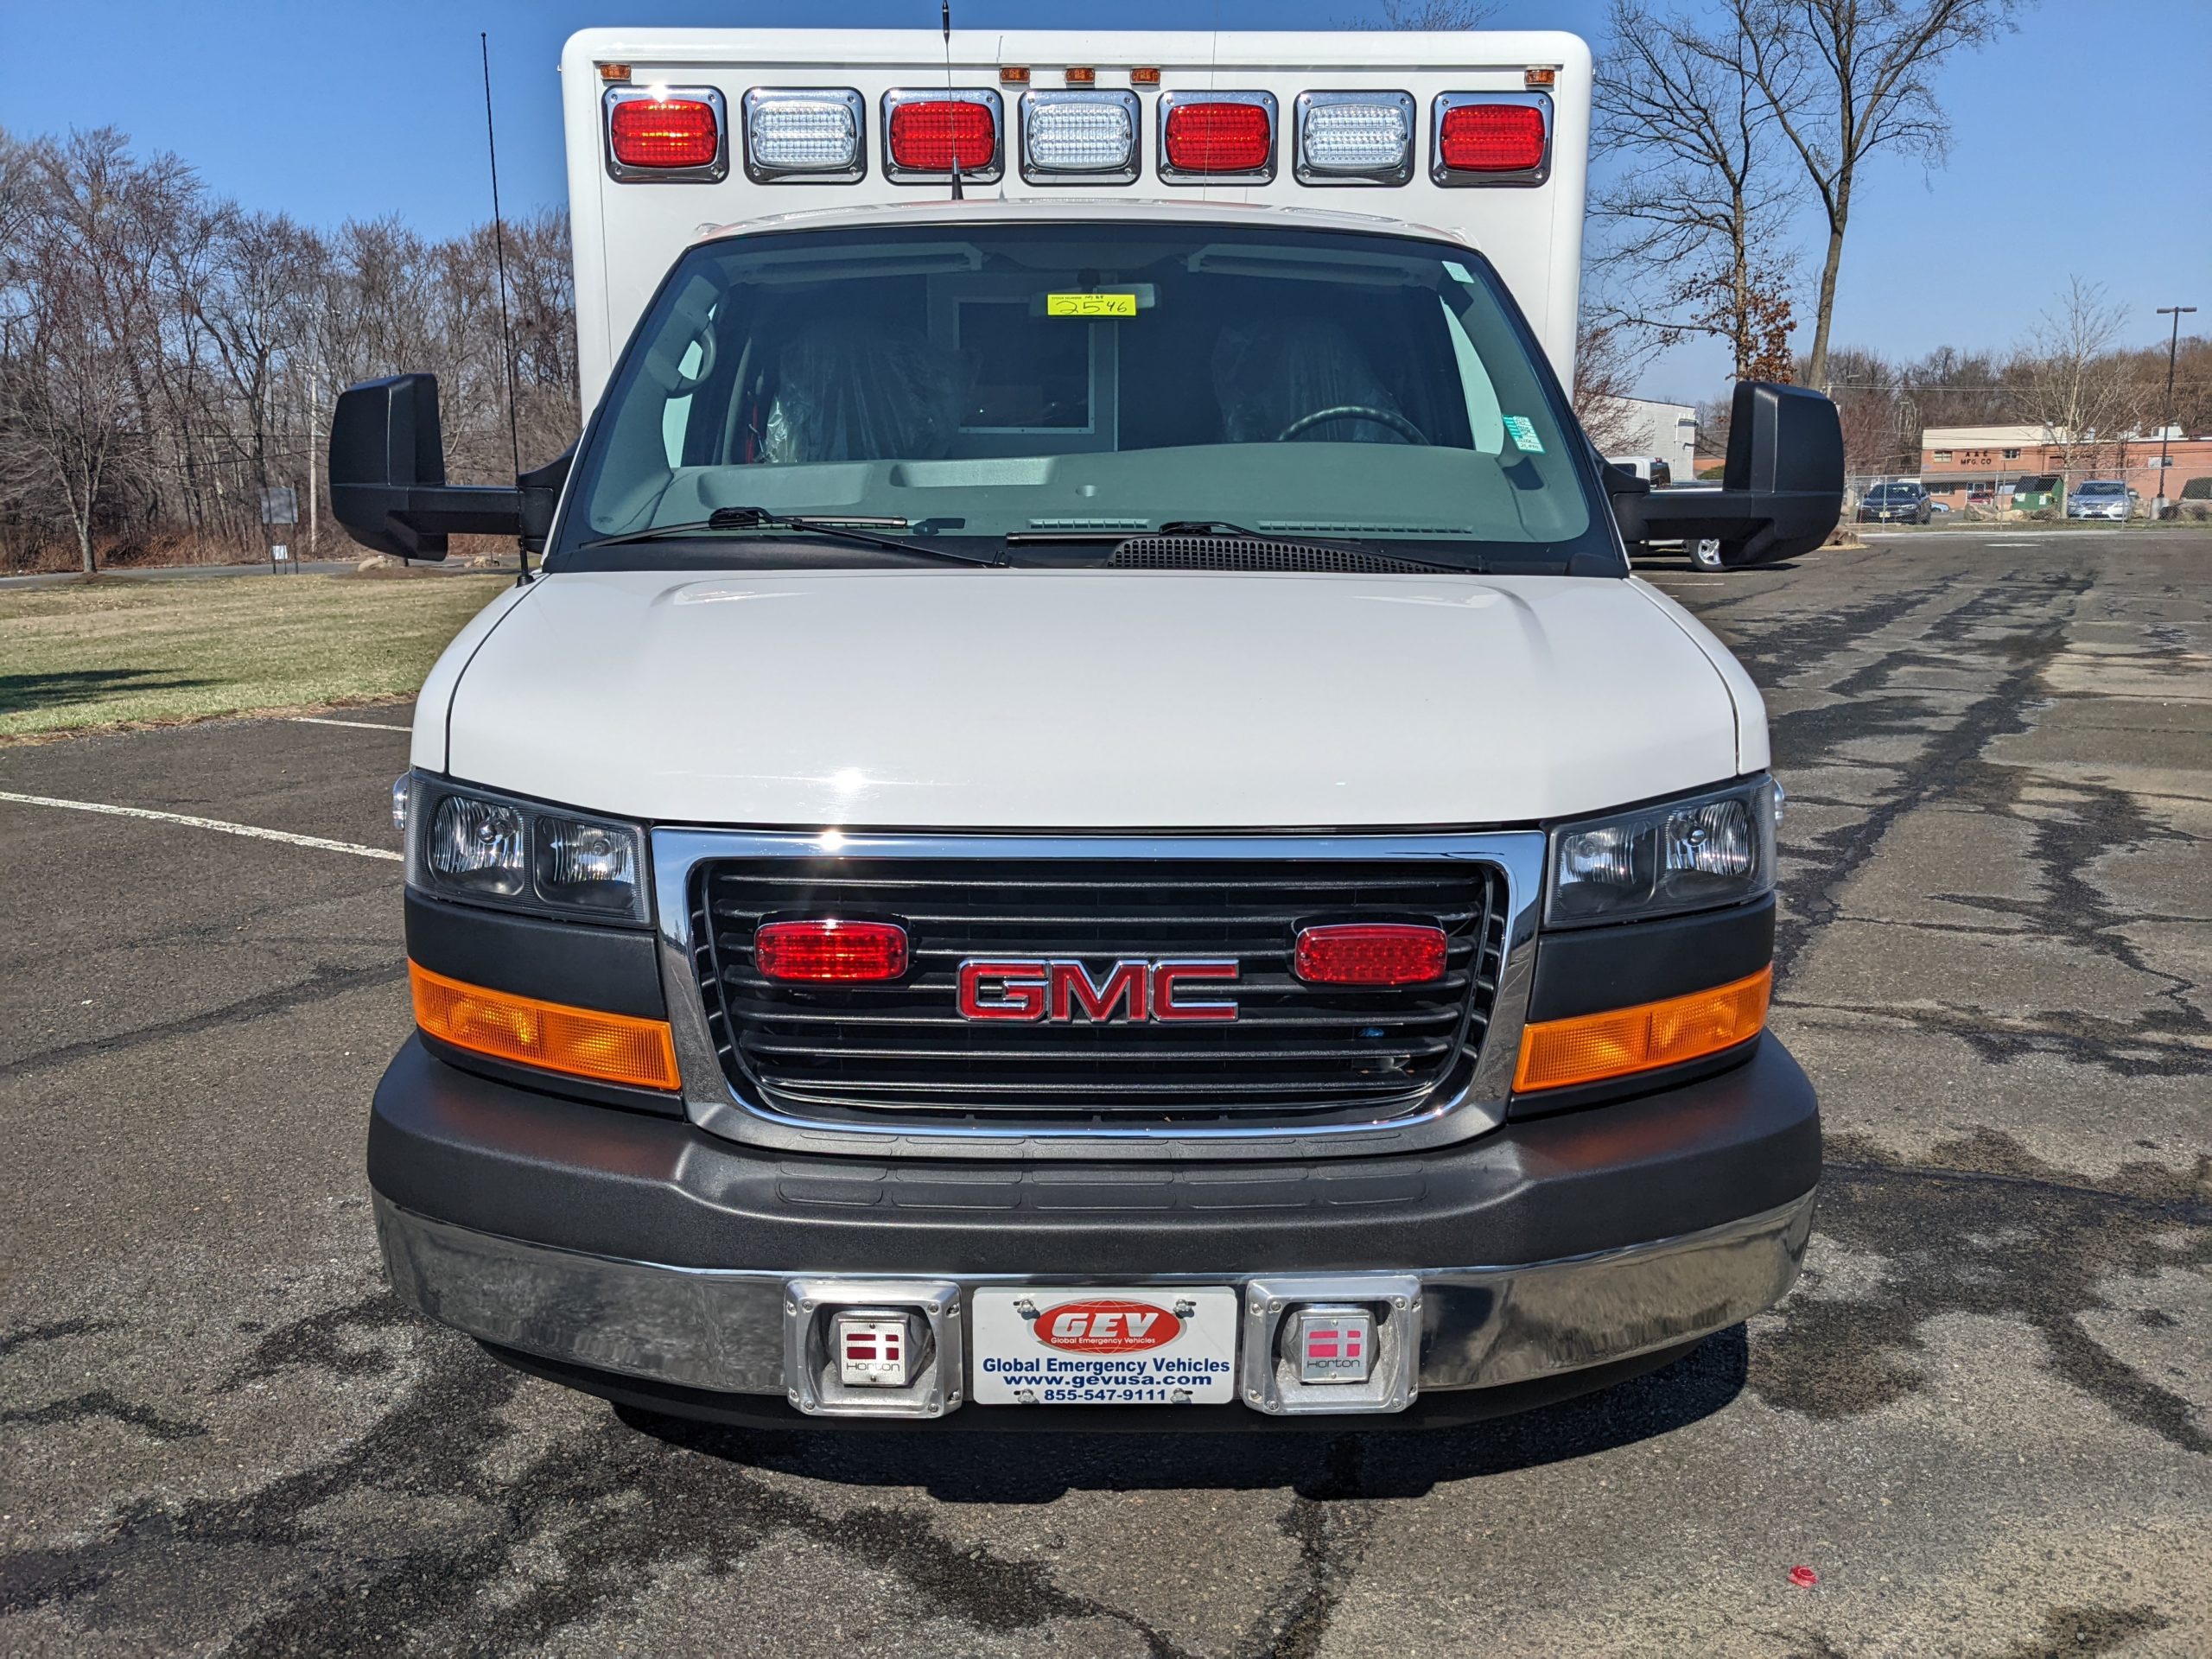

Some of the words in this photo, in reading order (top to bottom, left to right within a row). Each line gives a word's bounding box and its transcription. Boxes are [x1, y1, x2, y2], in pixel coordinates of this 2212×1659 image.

[1056, 301, 1128, 314] 2546
[956, 957, 1239, 1023] GMC
[1052, 1313, 1159, 1338] GEV
[1078, 1337, 1122, 1345] Emergency
[846, 1362, 900, 1371] Horton
[982, 1357, 1039, 1372] Global
[1046, 1358, 1147, 1376] Emergency
[1153, 1357, 1230, 1372] Vehicles
[1306, 1358, 1360, 1368] Horton
[1003, 1375, 1211, 1388] www.gevusa.com
[1044, 1389, 1166, 1401] 855-547-9111
